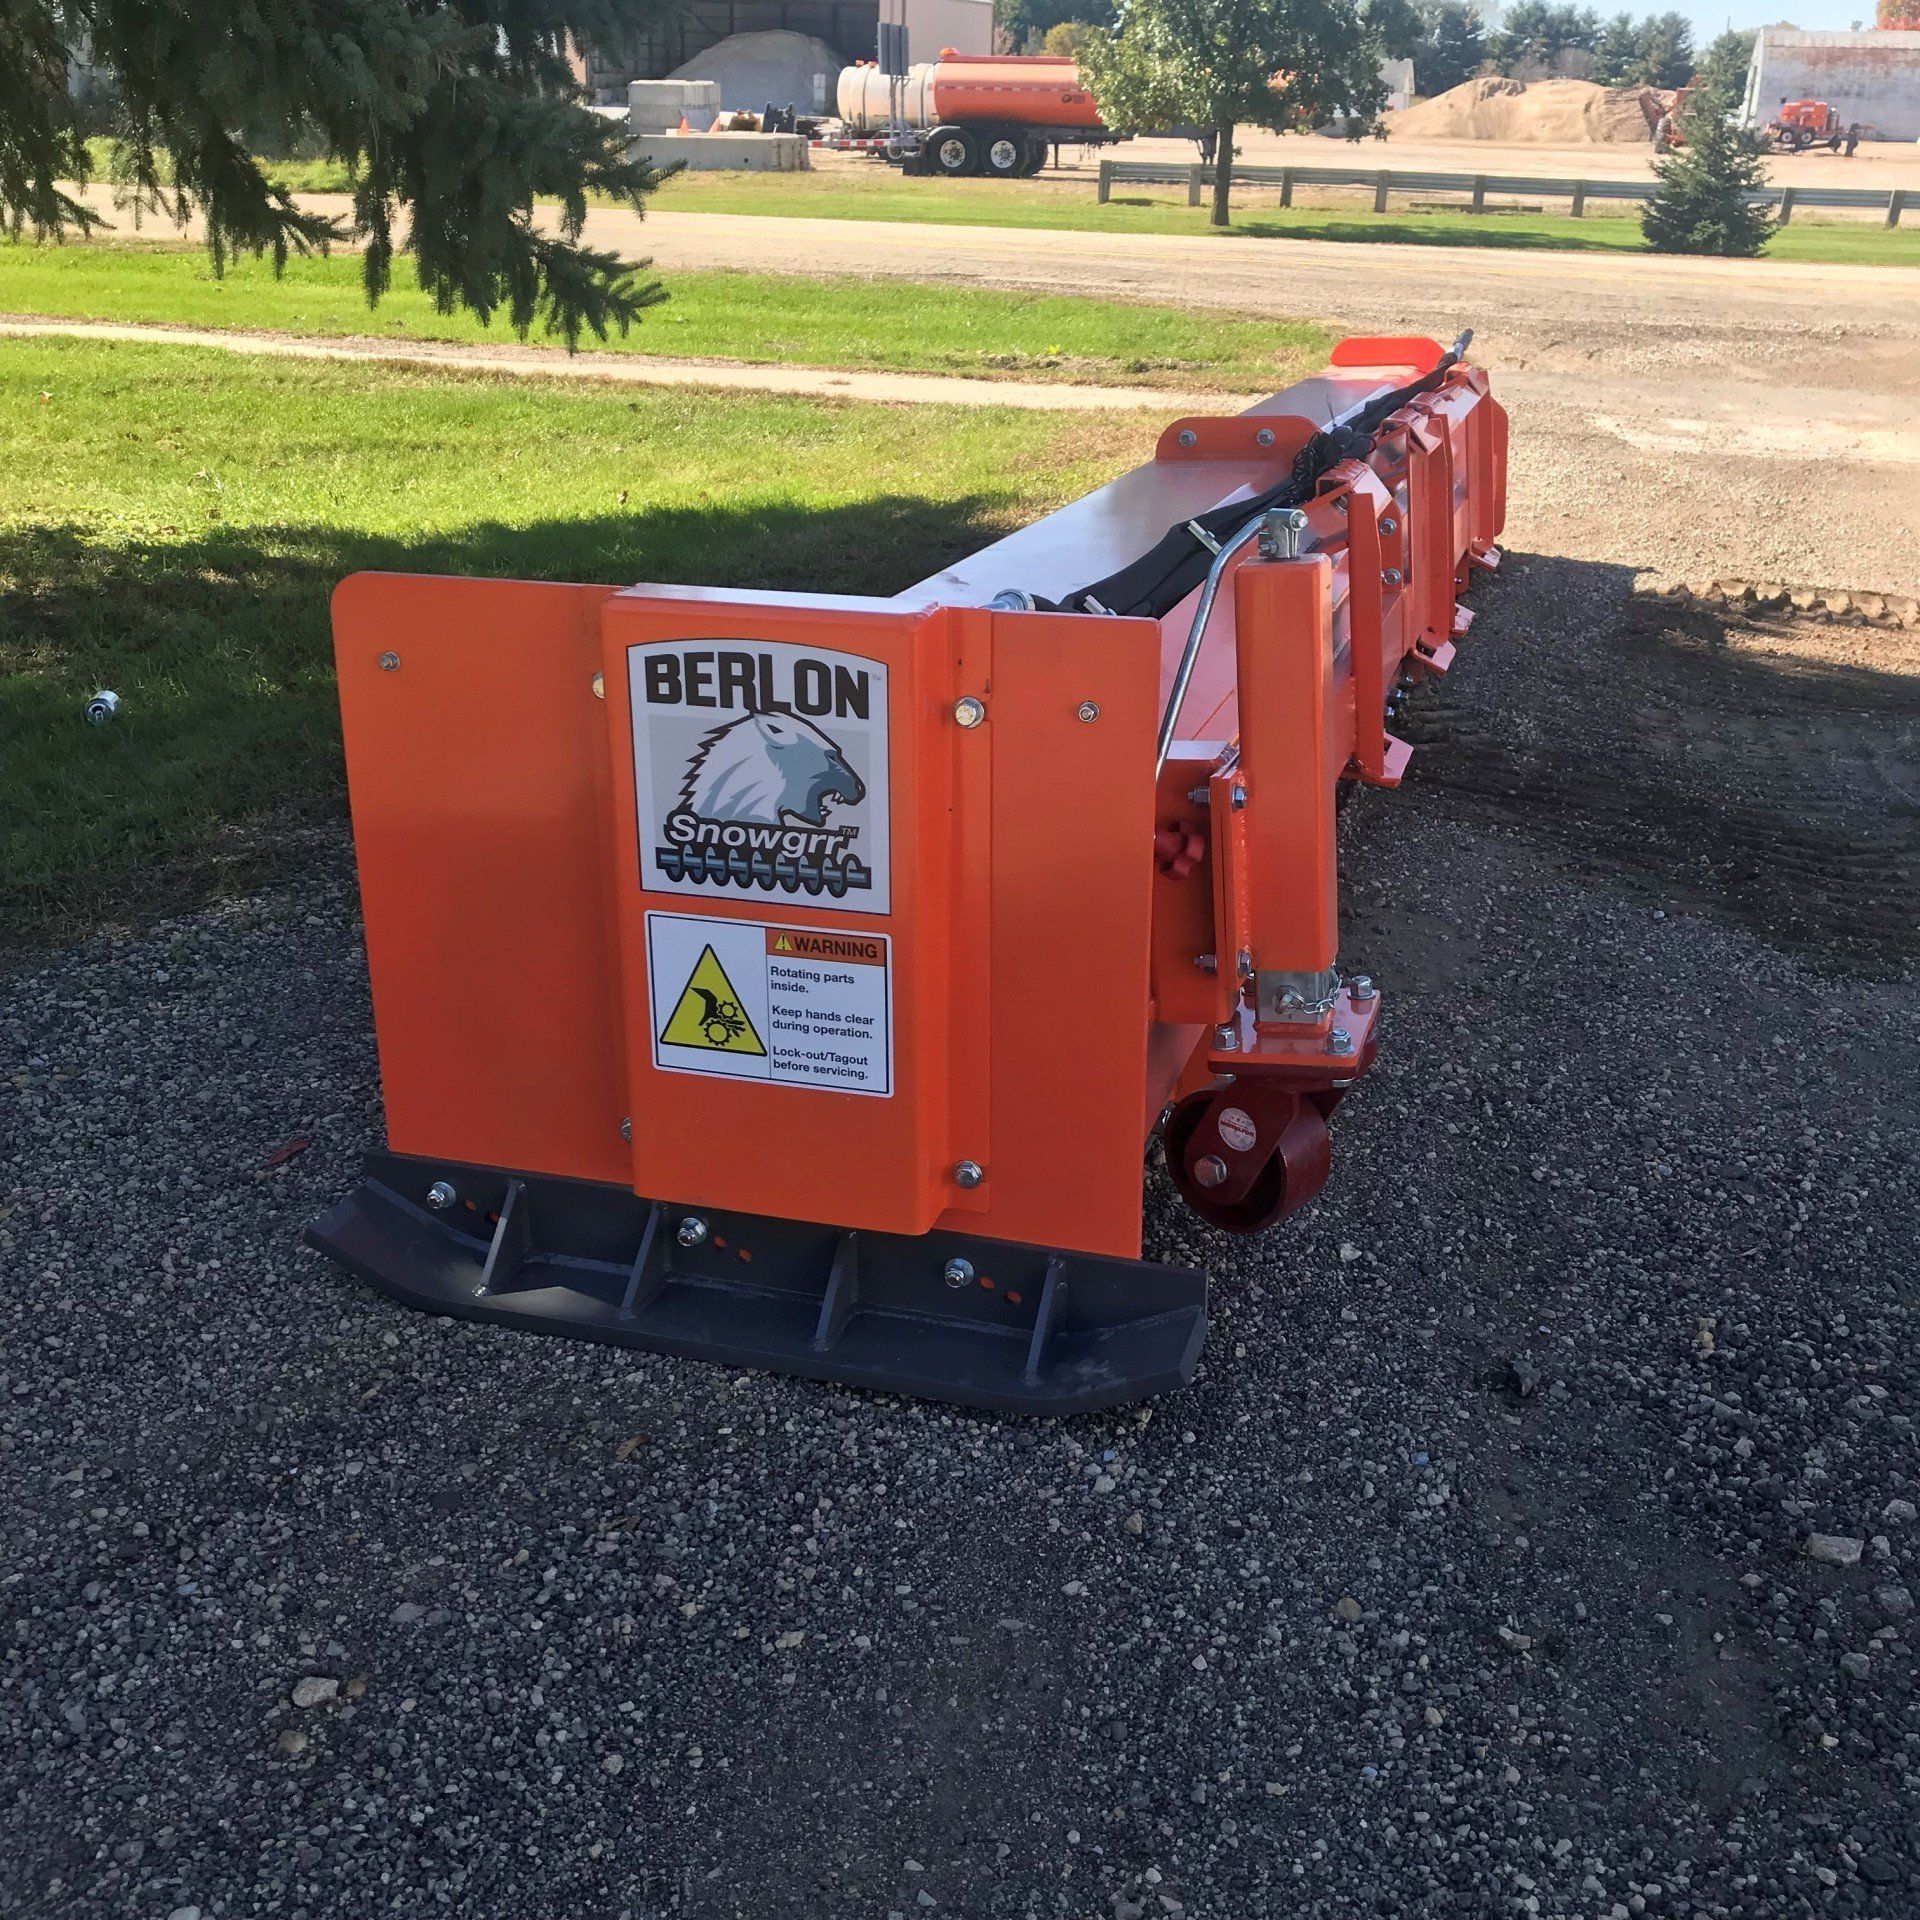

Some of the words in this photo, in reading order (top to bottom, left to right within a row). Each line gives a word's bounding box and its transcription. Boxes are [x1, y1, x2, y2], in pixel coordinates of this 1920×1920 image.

[645, 652, 869, 719] BERLON
[670, 814, 844, 858] Snowgrr
[794, 937, 878, 958] WARNING
[770, 966, 820, 983] Rotating
[824, 973, 855, 984] parts
[771, 980, 809, 993] inside.
[772, 1005, 802, 1019] Keep
[806, 1009, 841, 1022] hands
[845, 1014, 875, 1025] clear
[772, 1020, 810, 1034] during
[813, 1025, 873, 1039] operation.
[773, 1046, 868, 1065] Lock-out/Tagout
[773, 1059, 810, 1072] before
[813, 1065, 869, 1081] servicing.
